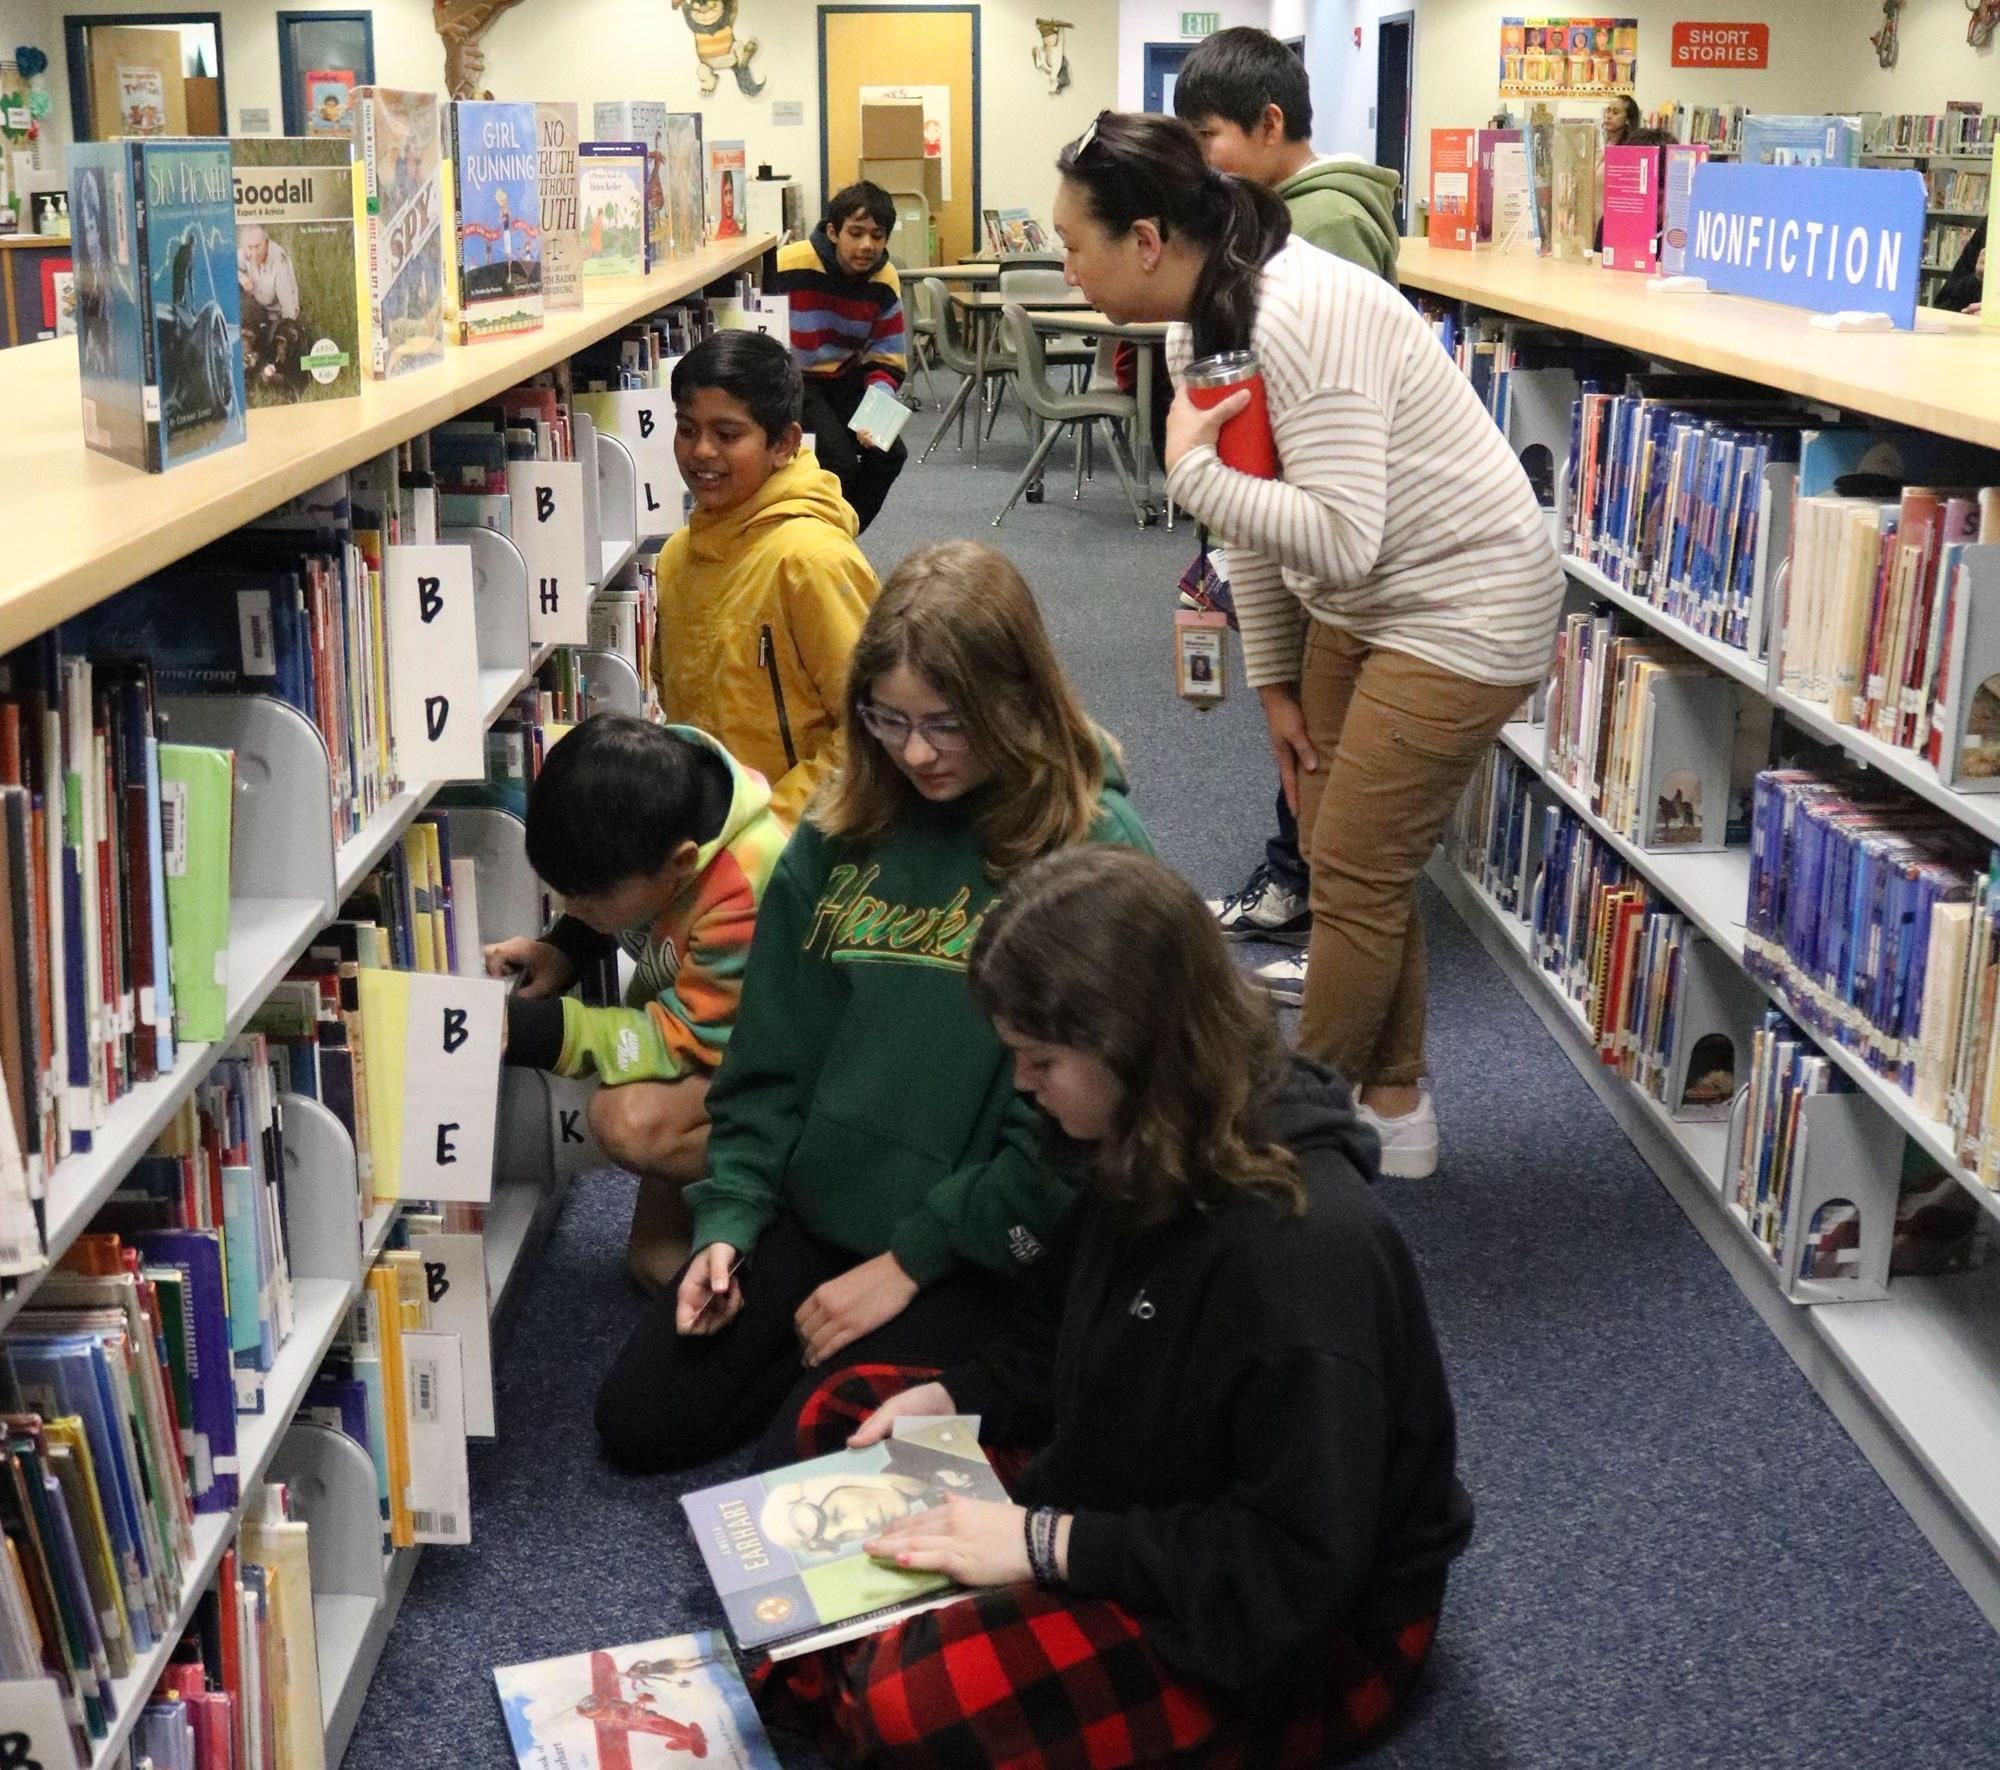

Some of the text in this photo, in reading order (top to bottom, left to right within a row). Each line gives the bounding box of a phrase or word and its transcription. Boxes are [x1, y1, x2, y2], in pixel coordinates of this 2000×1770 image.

[1187, 14, 1216, 34] EXIT
[1689, 30, 1749, 45] SHORT
[1678, 46, 1758, 61] STORIES
[482, 121, 520, 149] GIRL
[543, 120, 565, 147] NO
[467, 153, 536, 191] RUNNING
[537, 150, 575, 177] RUTH
[232, 178, 313, 205] Goodall
[539, 178, 575, 196] ITHOUT
[237, 208, 257, 217] Expert
[541, 198, 577, 231] UTH
[390, 180, 434, 280] SPY
[1695, 210, 1902, 292] NONFICTION
[638, 409, 655, 439] B
[535, 486, 555, 523] B
[644, 482, 660, 511] L
[418, 577, 444, 624] B
[540, 577, 559, 614] H
[154, 669, 236, 681] rmstrong
[425, 695, 449, 742] D
[443, 1007, 469, 1054] B
[559, 1110, 584, 1144] K
[436, 1122, 460, 1166] E
[424, 1262, 450, 1302] B
[712, 1526, 732, 1556] AMELIA
[718, 1499, 770, 1571] EARHART
